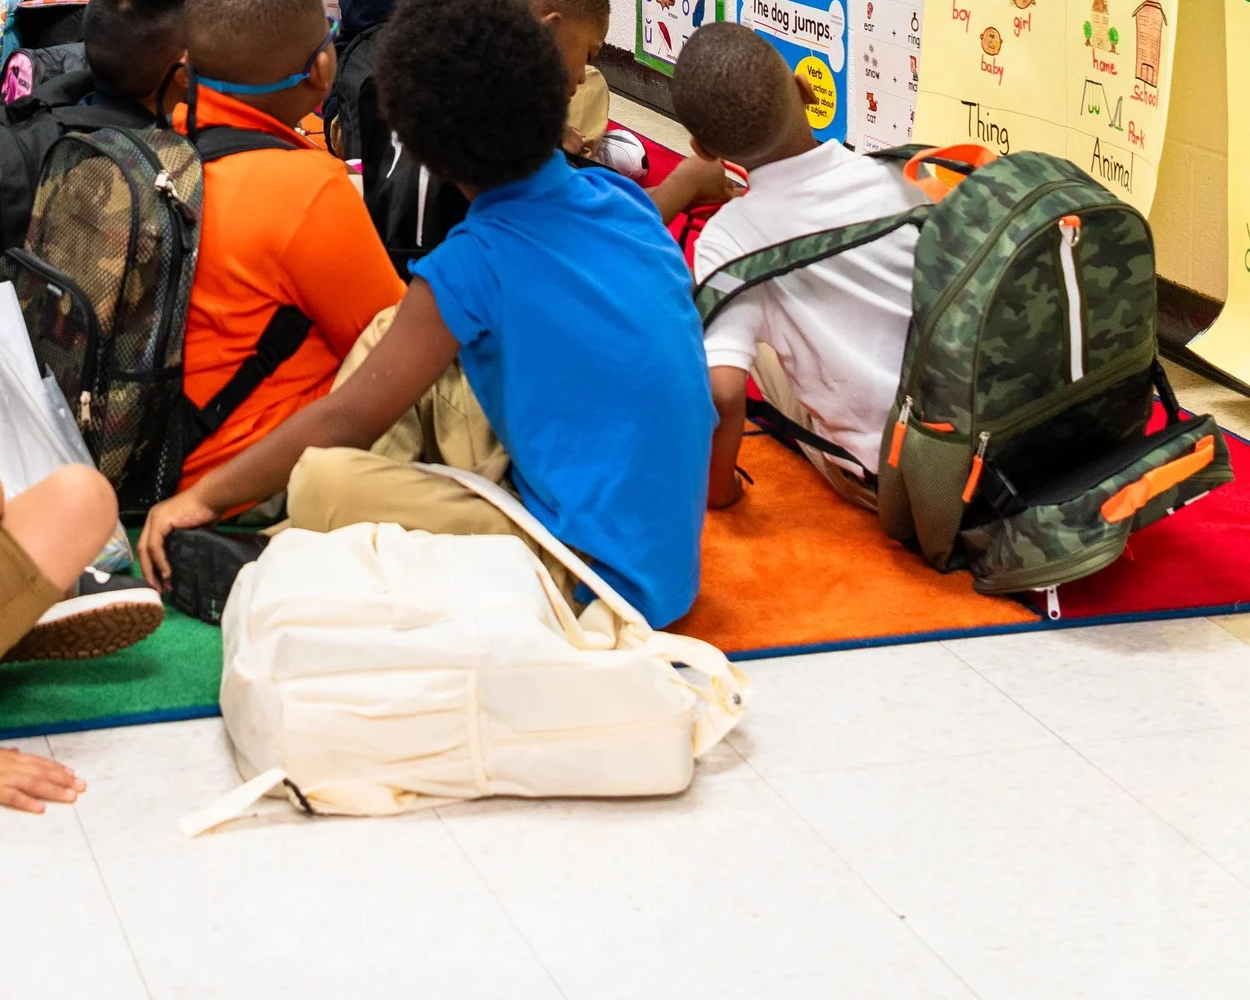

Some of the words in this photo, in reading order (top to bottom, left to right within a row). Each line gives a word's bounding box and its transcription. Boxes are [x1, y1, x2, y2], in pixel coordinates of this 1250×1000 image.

[772, 3, 789, 30] dog
[792, 10, 833, 41] jumps.
[952, 0, 970, 33] boy
[1013, 13, 1031, 37] girl
[864, 22, 875, 32] ear
[908, 33, 920, 49] ring
[807, 65, 822, 80] Verb
[865, 67, 880, 80] snow
[980, 55, 1004, 86] baby
[1092, 49, 1118, 76] home
[813, 83, 827, 94] action
[821, 98, 834, 108] about
[867, 112, 876, 124] cat
[961, 100, 1009, 156] Thing
[1091, 137, 1133, 194] Animal
